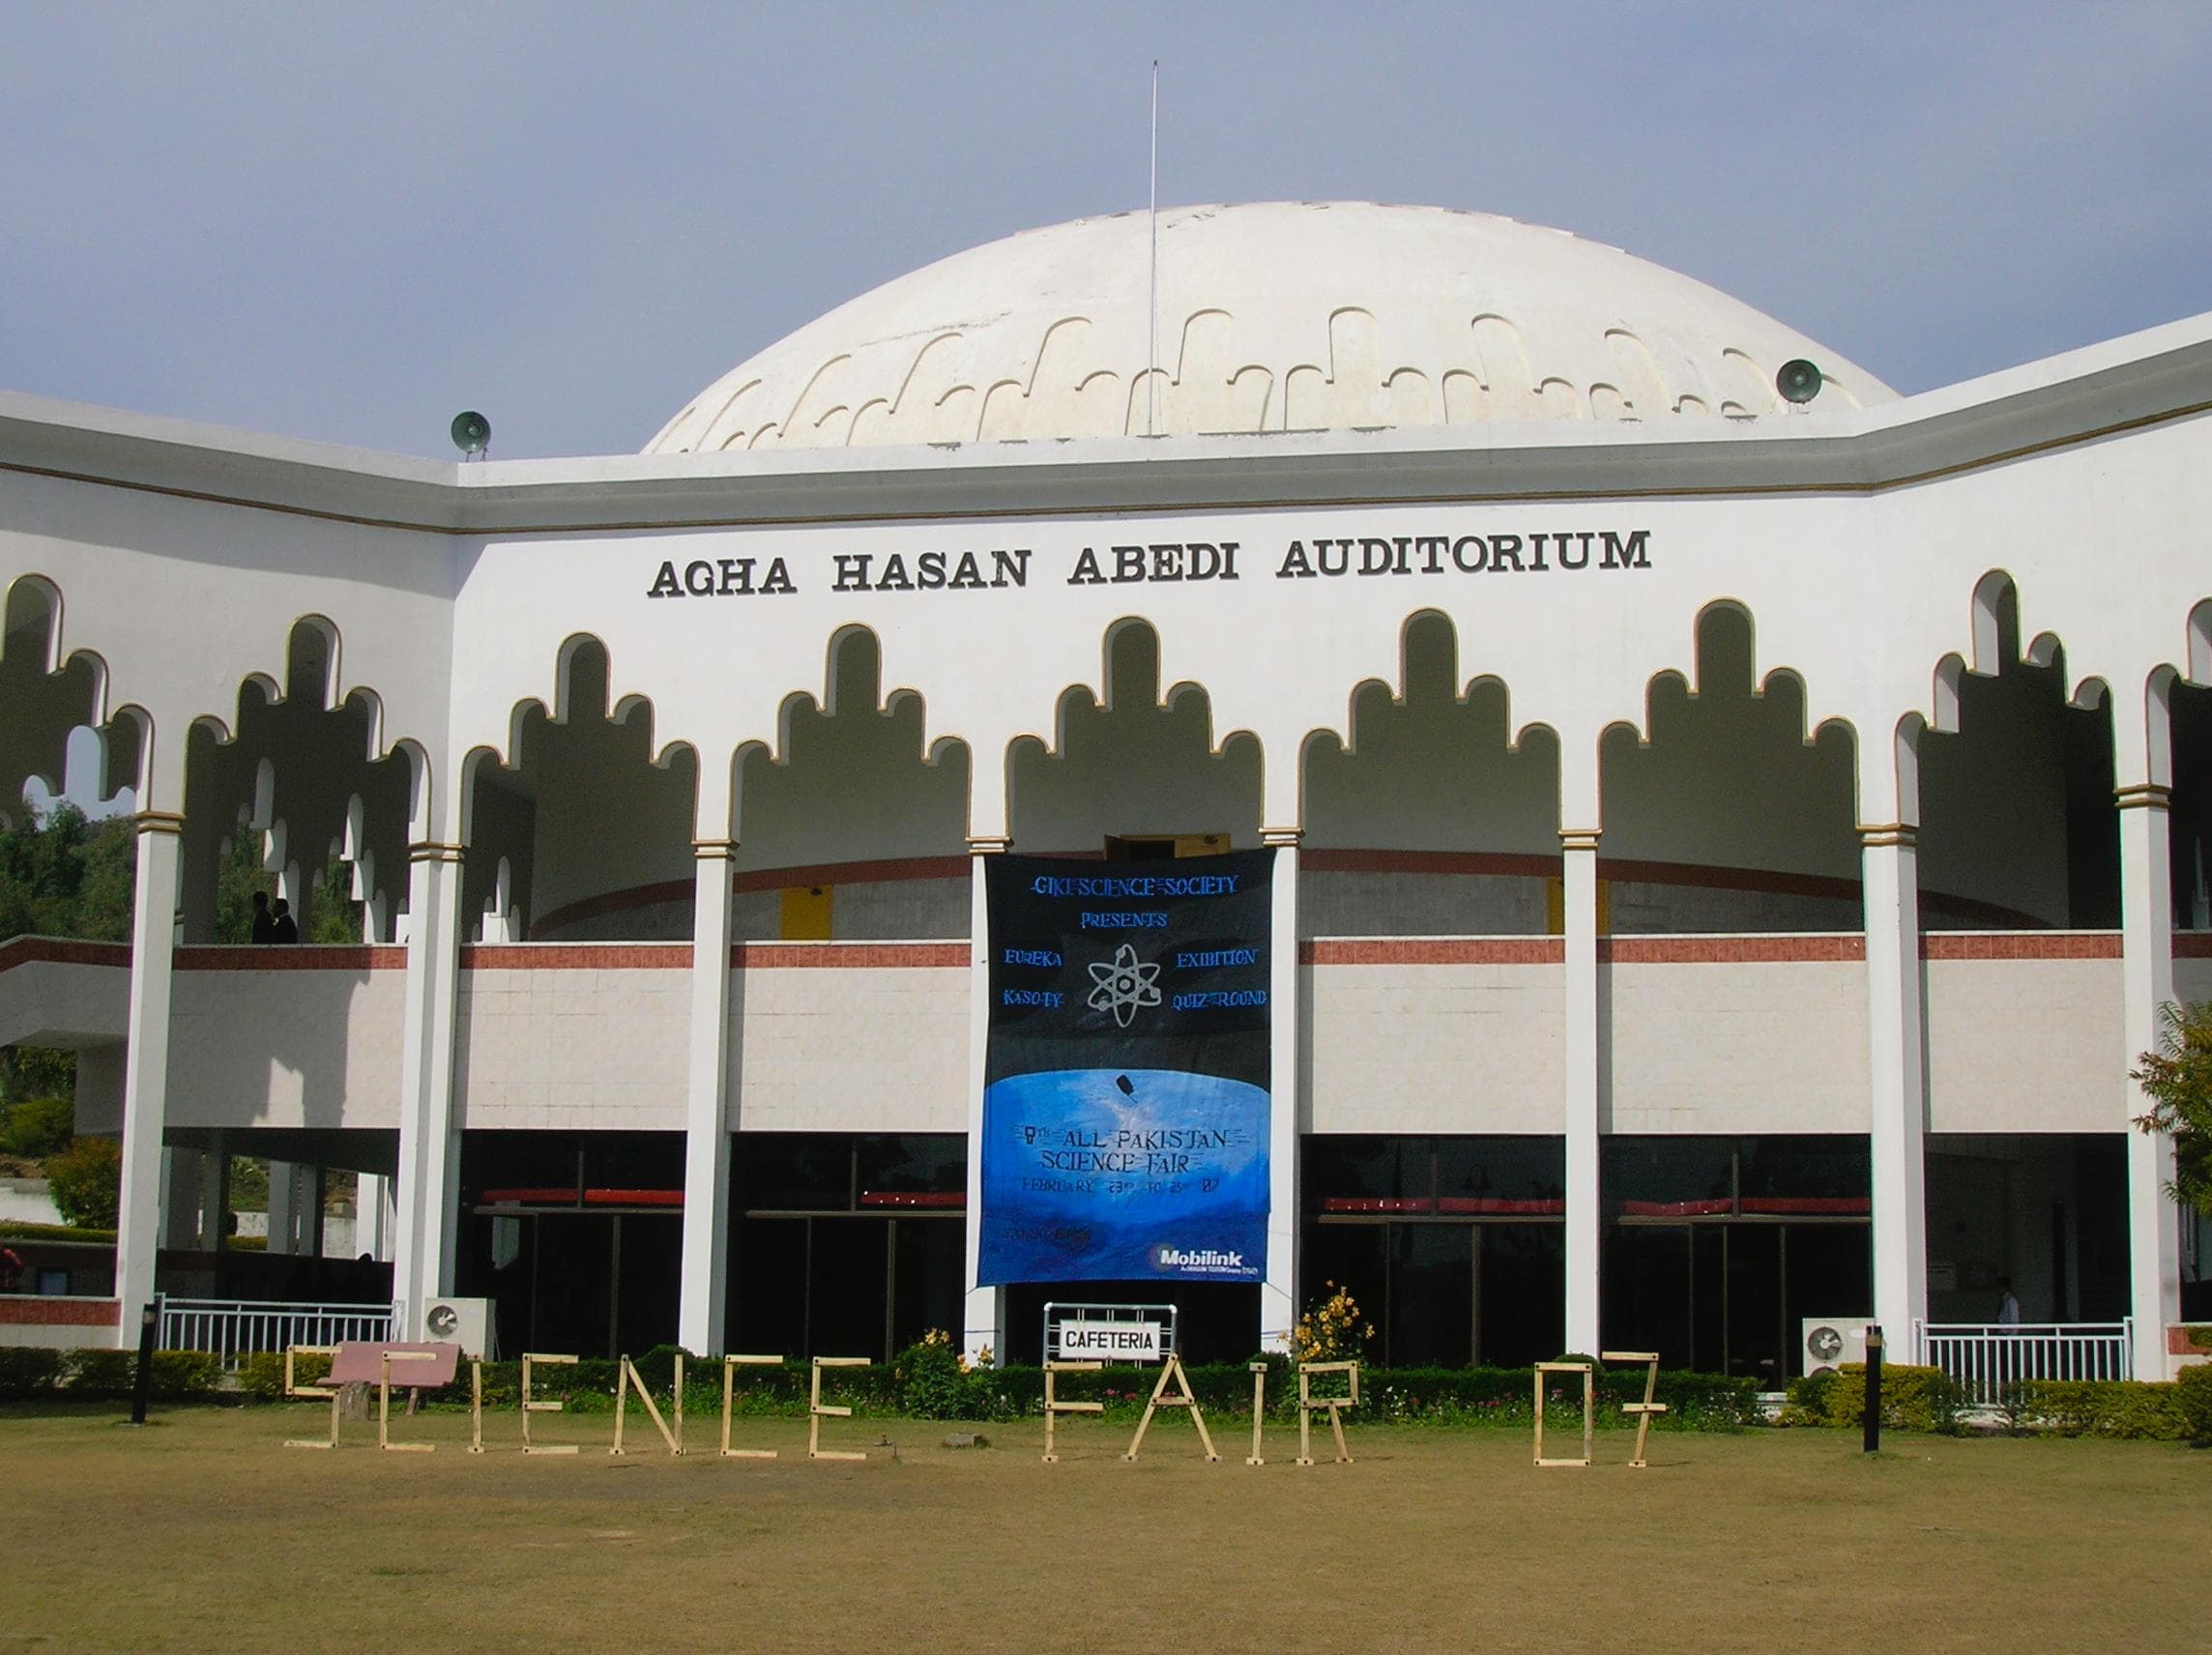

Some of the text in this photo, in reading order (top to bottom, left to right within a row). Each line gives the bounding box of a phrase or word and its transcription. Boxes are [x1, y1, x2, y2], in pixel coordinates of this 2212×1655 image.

[648, 531, 1652, 598] AGHA HASAN ABEDI AUDITORIUM
[1078, 877, 1155, 897] SCIENCE
[1164, 875, 1239, 895] SOCIETY
[1080, 913, 1169, 928] PRESENTS
[1004, 948, 1062, 967] EUREKA
[1176, 949, 1260, 968] EXIBITION
[1171, 990, 1267, 1011] QUIZ ROUND
[1062, 1129, 1107, 1148] ALL
[1117, 1129, 1229, 1150] PAKISTAN
[1041, 1150, 1191, 1175] SCIENCE FAIR
[1021, 1176, 1095, 1193] FEBRUARY
[1160, 1249, 1243, 1266] Mobilink
[1065, 1330, 1153, 1350] CAFETERIA
[1041, 1352, 1358, 1466] FAIR
